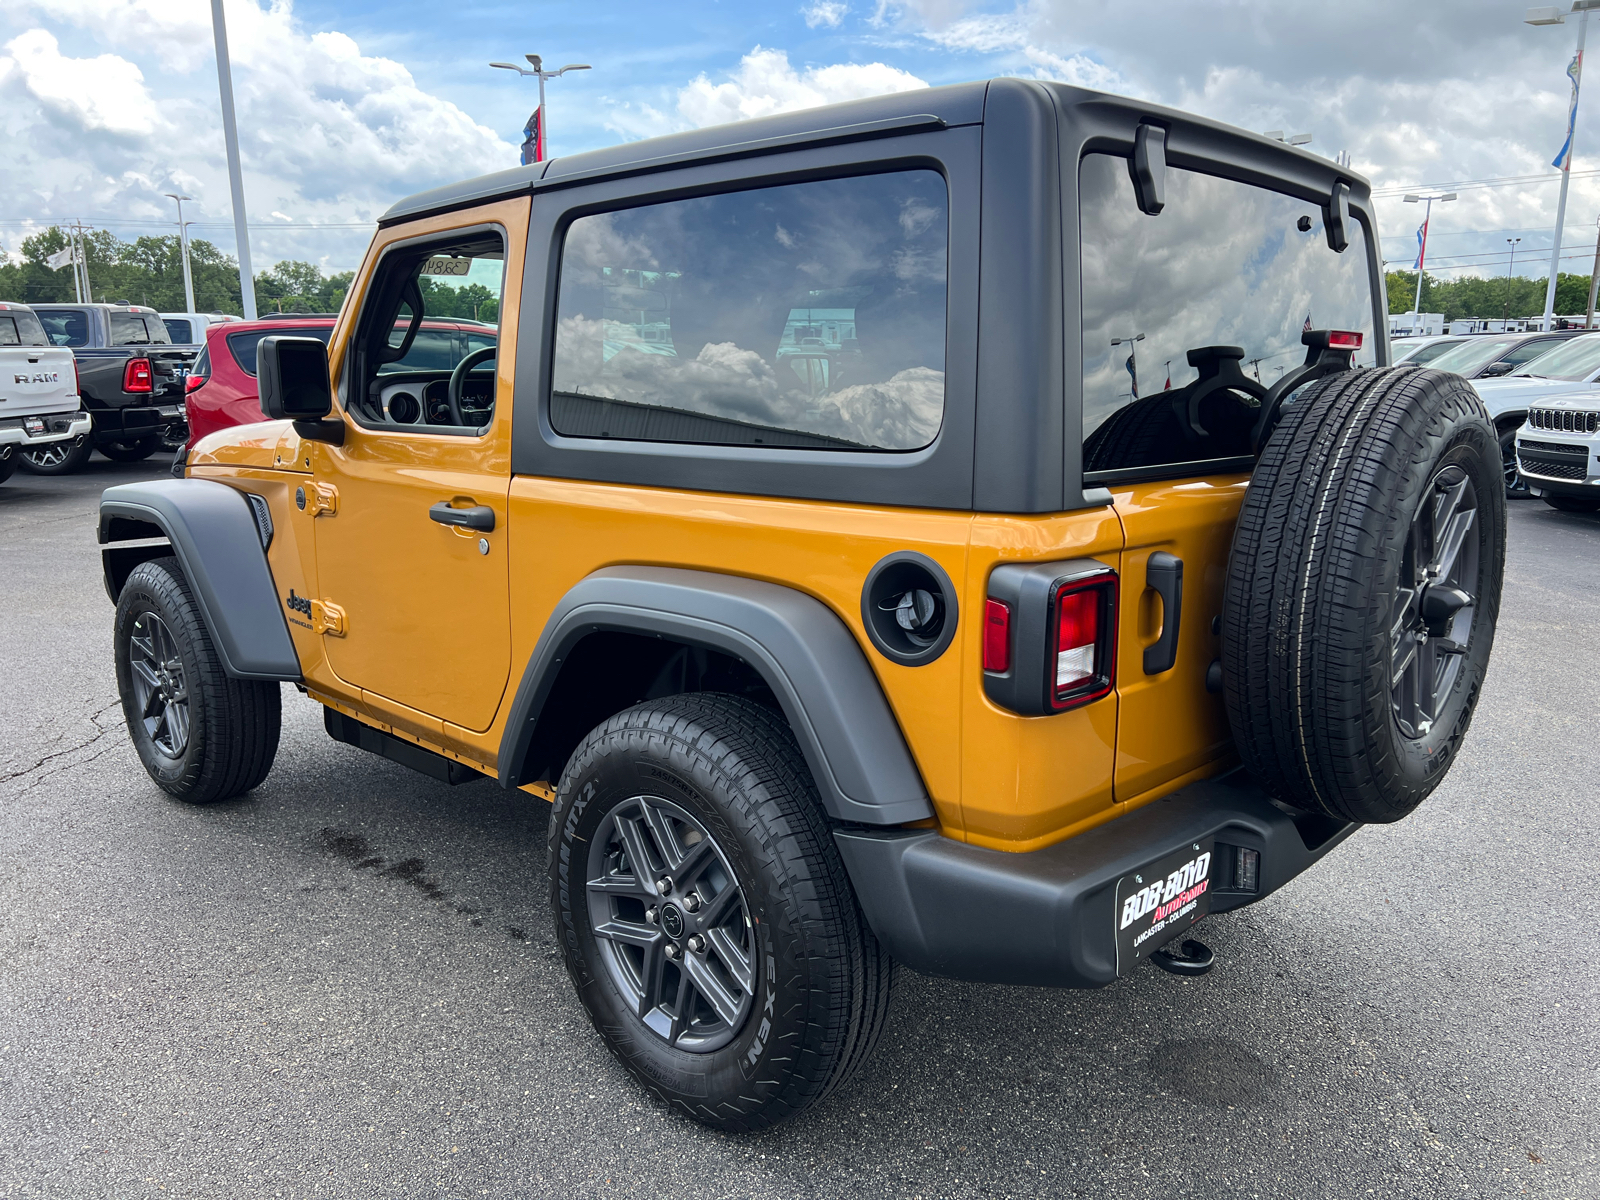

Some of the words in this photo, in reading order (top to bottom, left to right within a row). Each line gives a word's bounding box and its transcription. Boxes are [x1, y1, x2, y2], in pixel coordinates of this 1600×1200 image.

[14, 371, 58, 384] RAM
[287, 588, 312, 620] Jeep
[1428, 682, 1478, 775] NEXEN
[651, 768, 699, 800] 245/75R17
[563, 781, 596, 843] HTX2
[558, 841, 587, 968] ROADIAN
[1133, 920, 1166, 948] LANCASTER
[1169, 899, 1198, 924] COLUMBUS
[747, 922, 776, 1066] NEXEN
[643, 1063, 698, 1095] All-Weather
[646, 1056, 678, 1079] Performance
